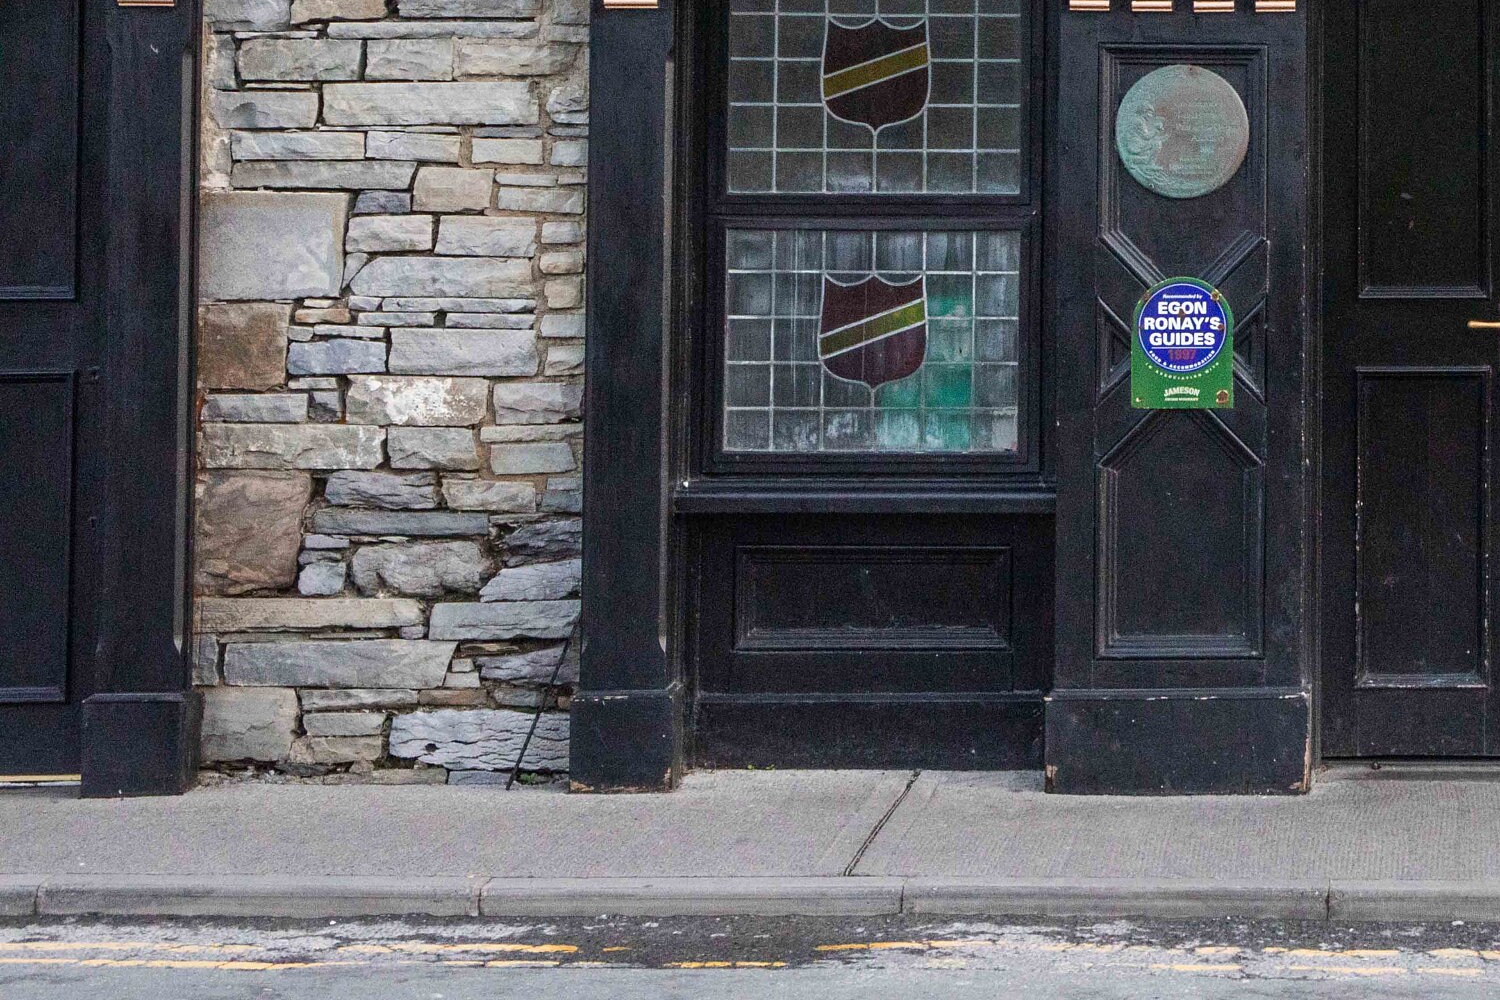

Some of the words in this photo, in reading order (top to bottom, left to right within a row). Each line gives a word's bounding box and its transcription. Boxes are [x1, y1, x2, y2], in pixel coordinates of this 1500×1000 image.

[1157, 301, 1207, 315] EGON
[1143, 317, 1221, 331] RONAY'S
[1149, 332, 1216, 346] GUIDES
[1163, 386, 1201, 397] JAMESON
